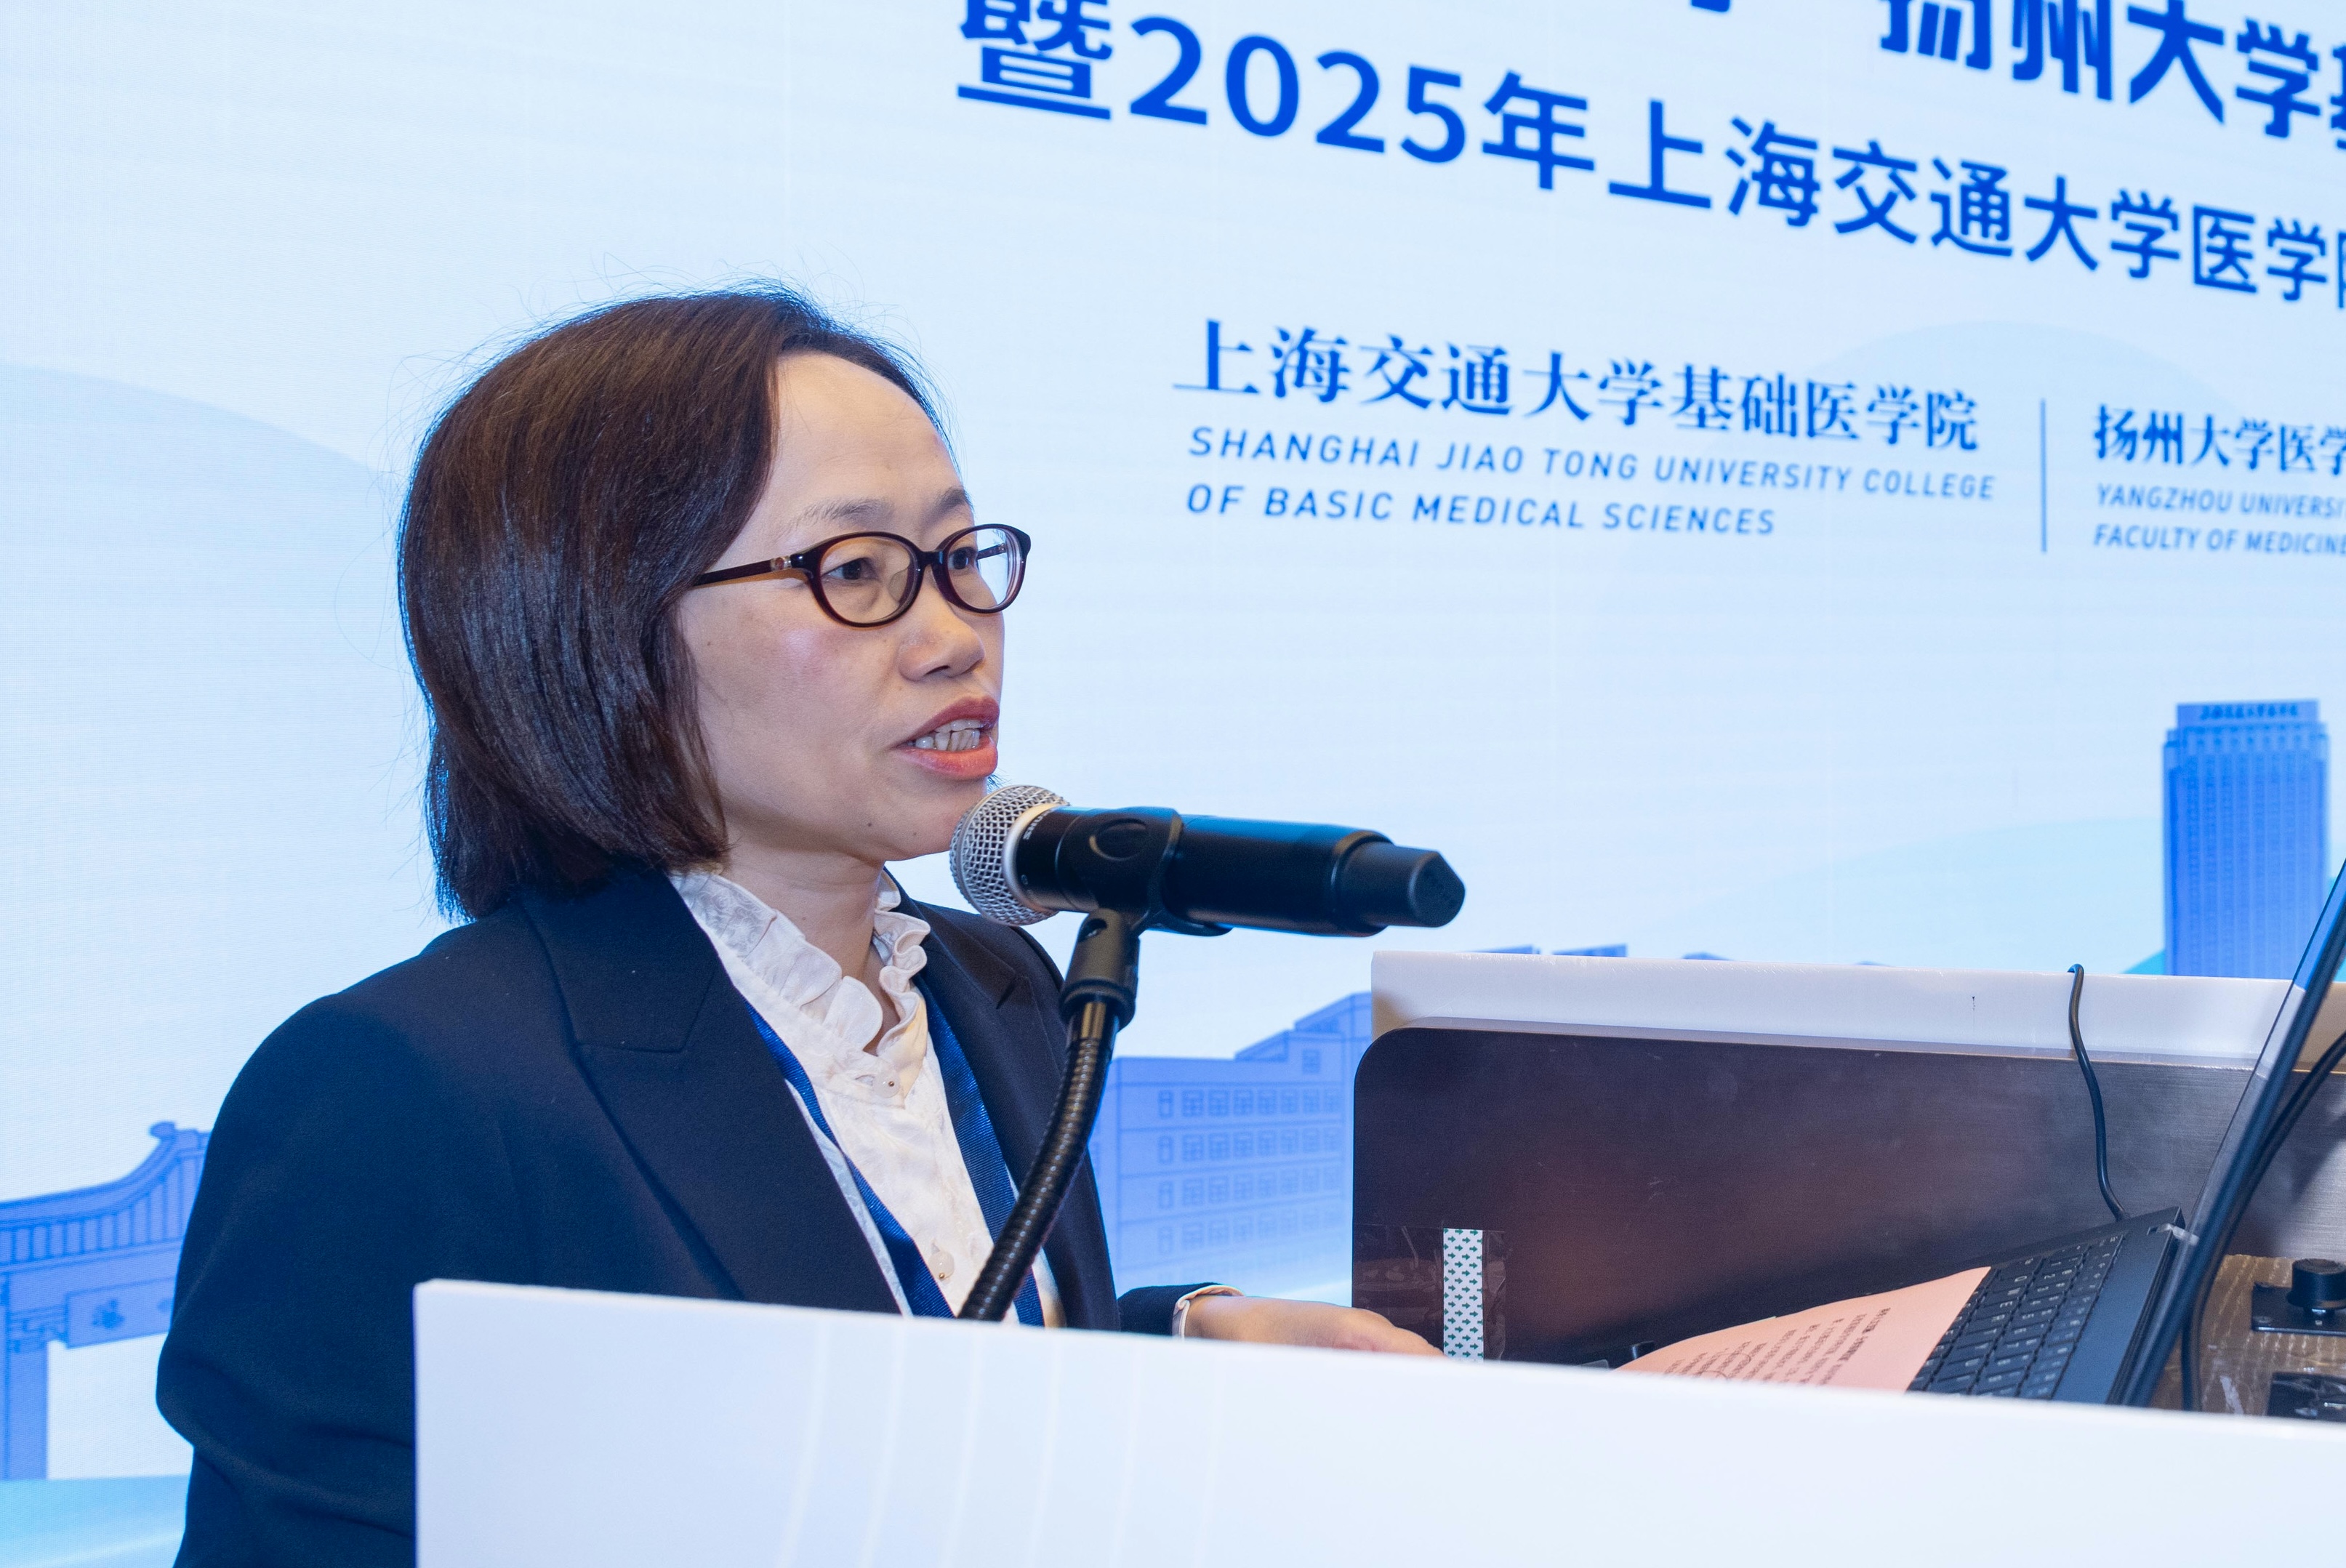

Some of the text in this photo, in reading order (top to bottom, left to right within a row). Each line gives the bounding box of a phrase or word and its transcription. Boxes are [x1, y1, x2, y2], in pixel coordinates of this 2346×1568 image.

[957, 0, 2346, 310] 暨2025年上海交通大学医学
[1175, 319, 1978, 451] 上海交通大学基础医学院
[1189, 427, 1995, 501] SHANGHAI JIAO TONG UNIVERSITY COLLEGE
[2093, 404, 2346, 476] 扬州大学医学
[1187, 484, 1774, 535] OF BASIC MEDICAL SCIENCES
[2097, 483, 2346, 519] YANGZHOU UNIVERSI
[2094, 523, 2200, 550] FACULTY
[2206, 528, 2238, 552] OF
